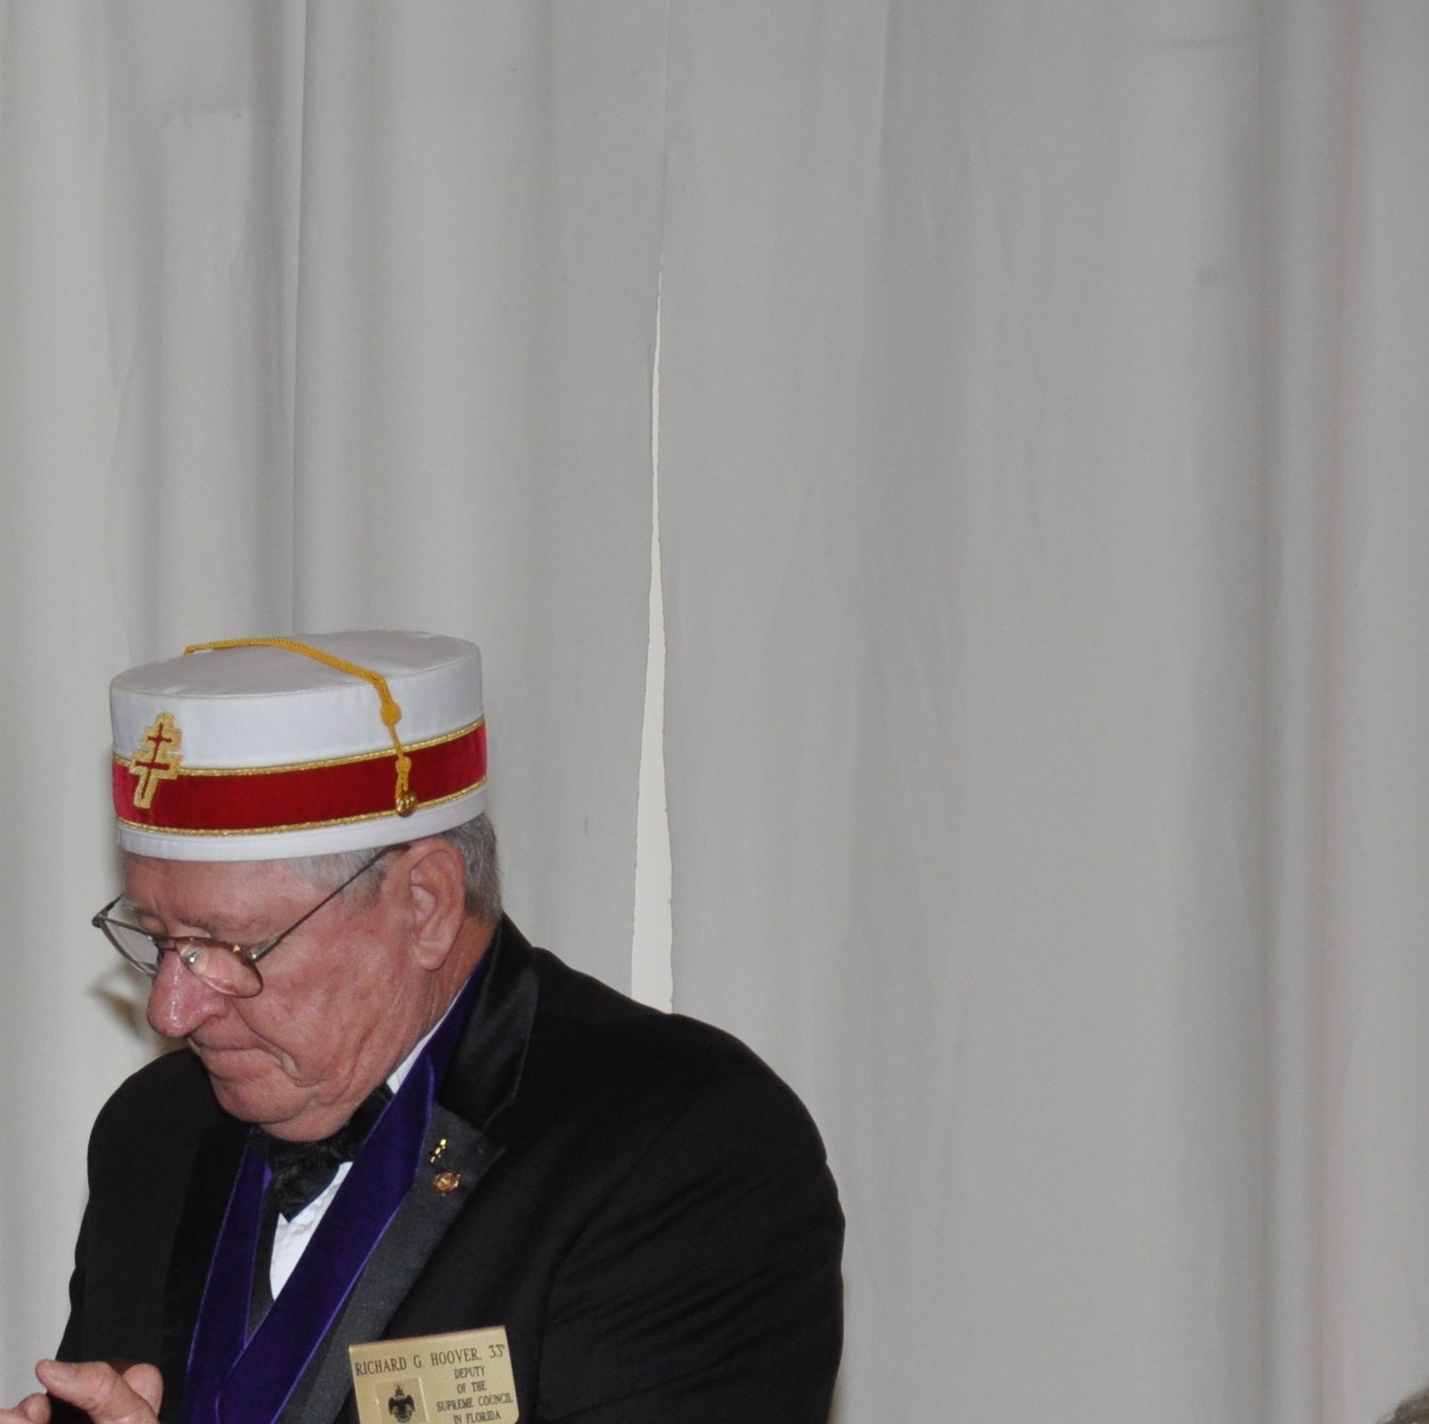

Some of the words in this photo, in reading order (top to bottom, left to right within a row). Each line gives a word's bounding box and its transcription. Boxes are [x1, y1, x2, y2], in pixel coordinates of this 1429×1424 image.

[355, 1357, 407, 1376] RICHARD
[454, 1365, 486, 1379] DEPUTY
[456, 1382, 467, 1394] OF
[471, 1380, 487, 1392] THE
[436, 1397, 474, 1412] SUPREME
[478, 1392, 514, 1407] COUNCIL
[453, 1414, 463, 1424] IN
[466, 1410, 502, 1424] FLORIDA
